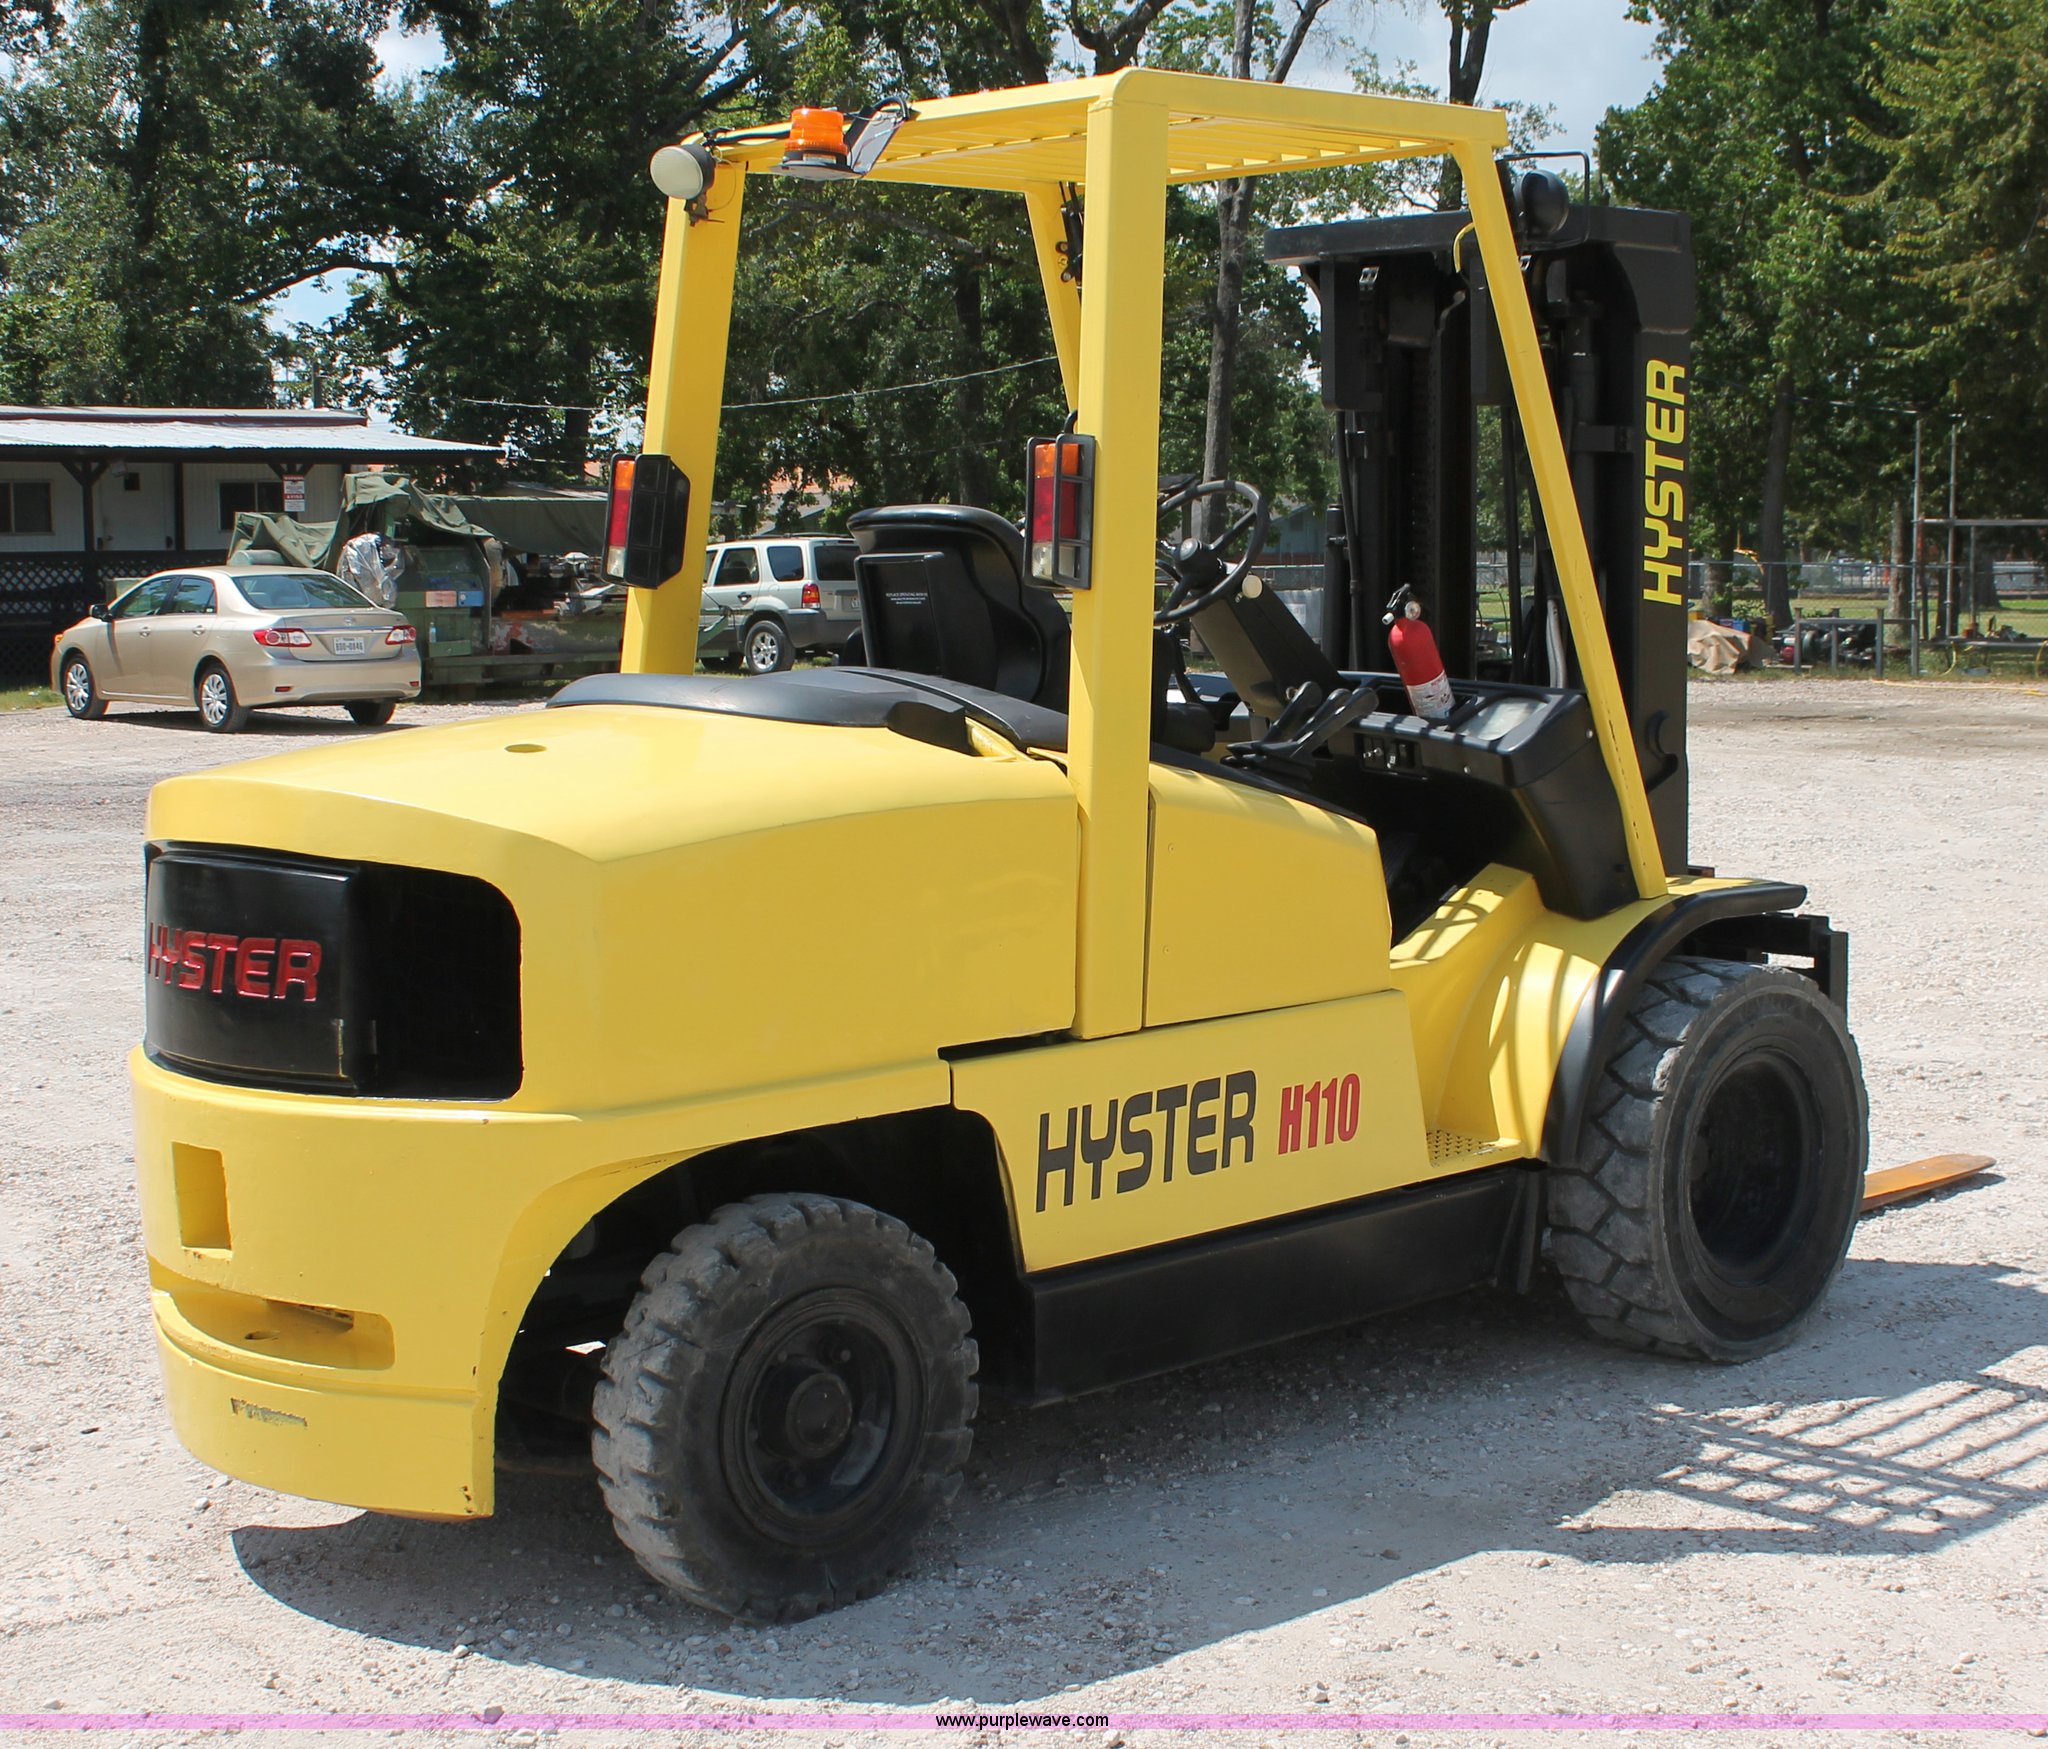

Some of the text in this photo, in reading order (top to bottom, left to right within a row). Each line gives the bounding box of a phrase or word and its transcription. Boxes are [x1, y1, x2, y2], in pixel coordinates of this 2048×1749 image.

[1643, 359, 1686, 606] HYSTER
[147, 922, 322, 1002] HYSTER
[1035, 1070, 1361, 1213] HYSTER H110
